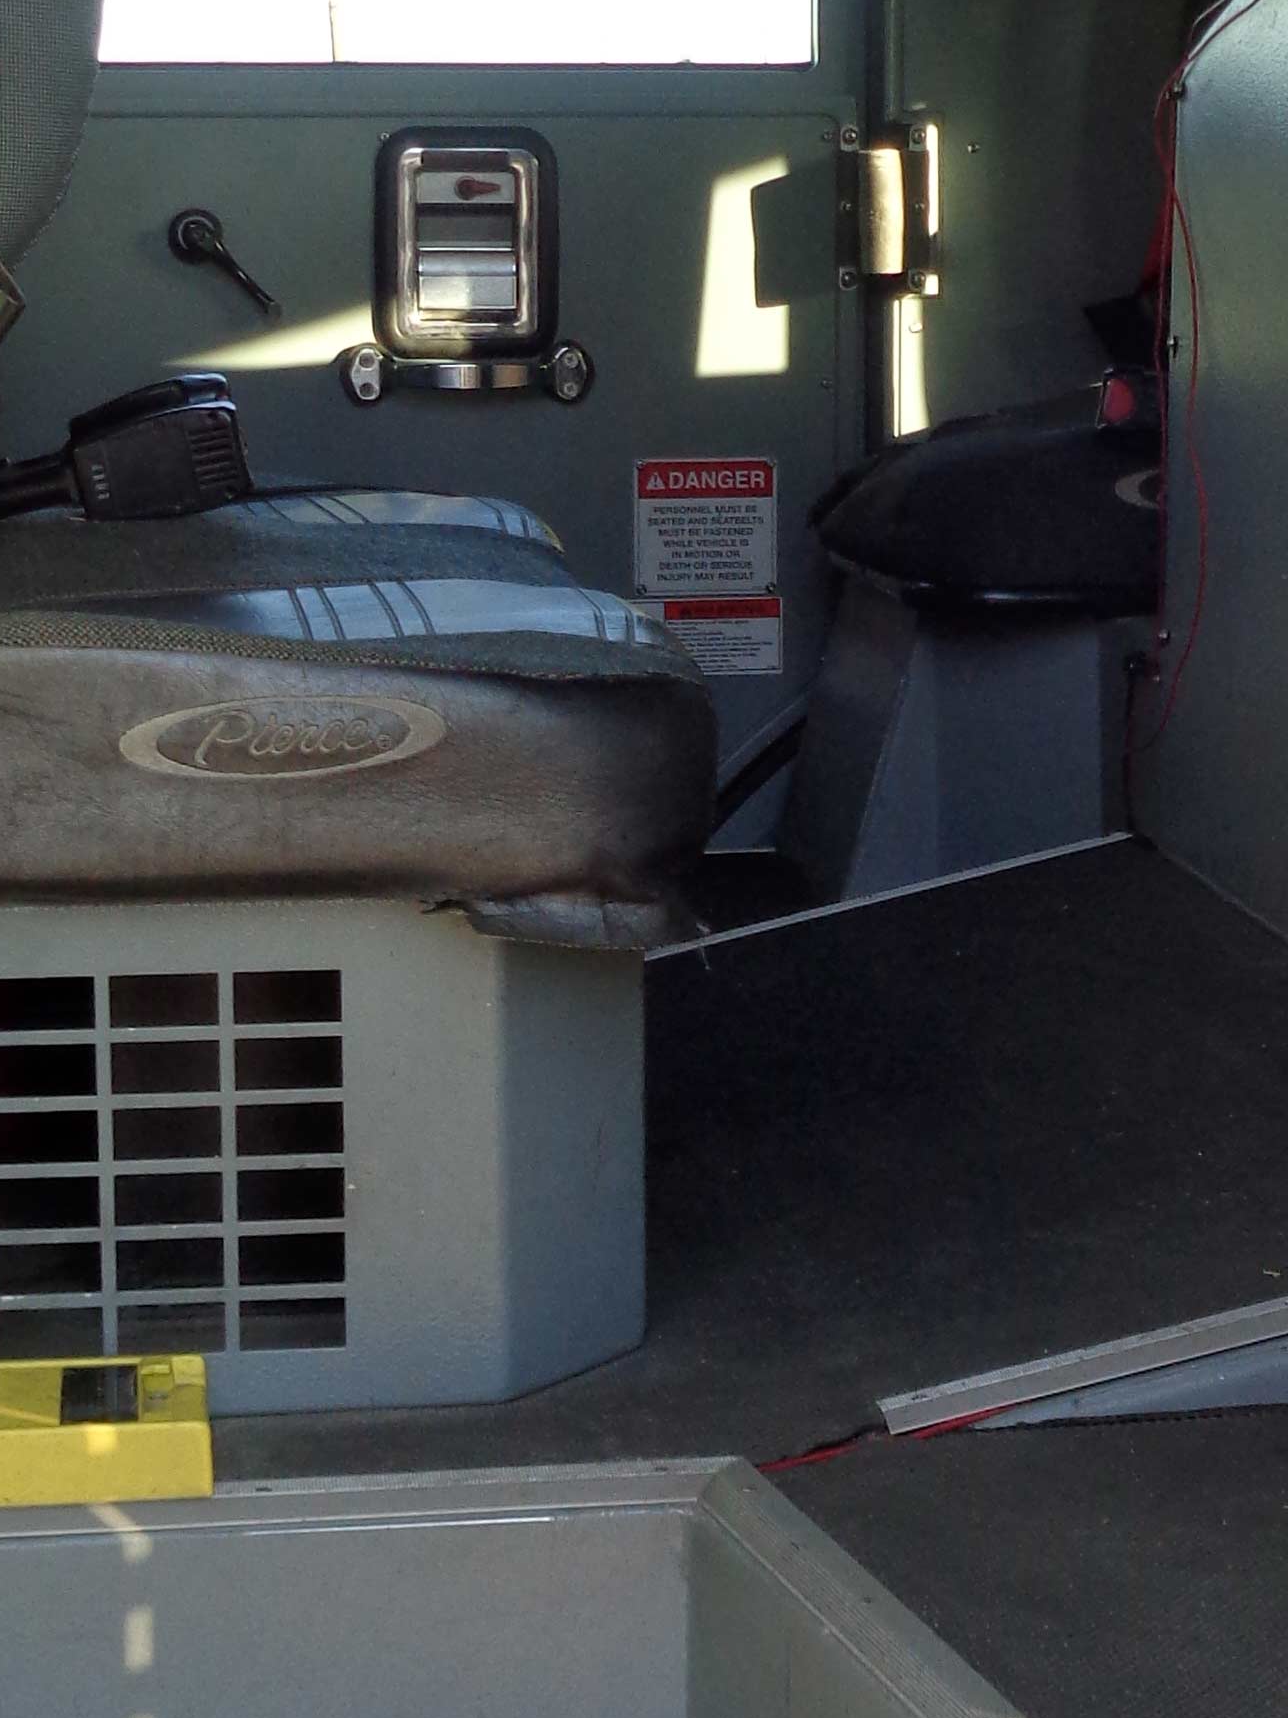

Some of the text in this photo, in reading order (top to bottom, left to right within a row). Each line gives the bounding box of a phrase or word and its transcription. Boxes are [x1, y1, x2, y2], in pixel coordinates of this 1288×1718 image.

[669, 470, 765, 489] DANGER
[694, 572, 715, 580] MAY
[194, 709, 372, 766] Pierce
